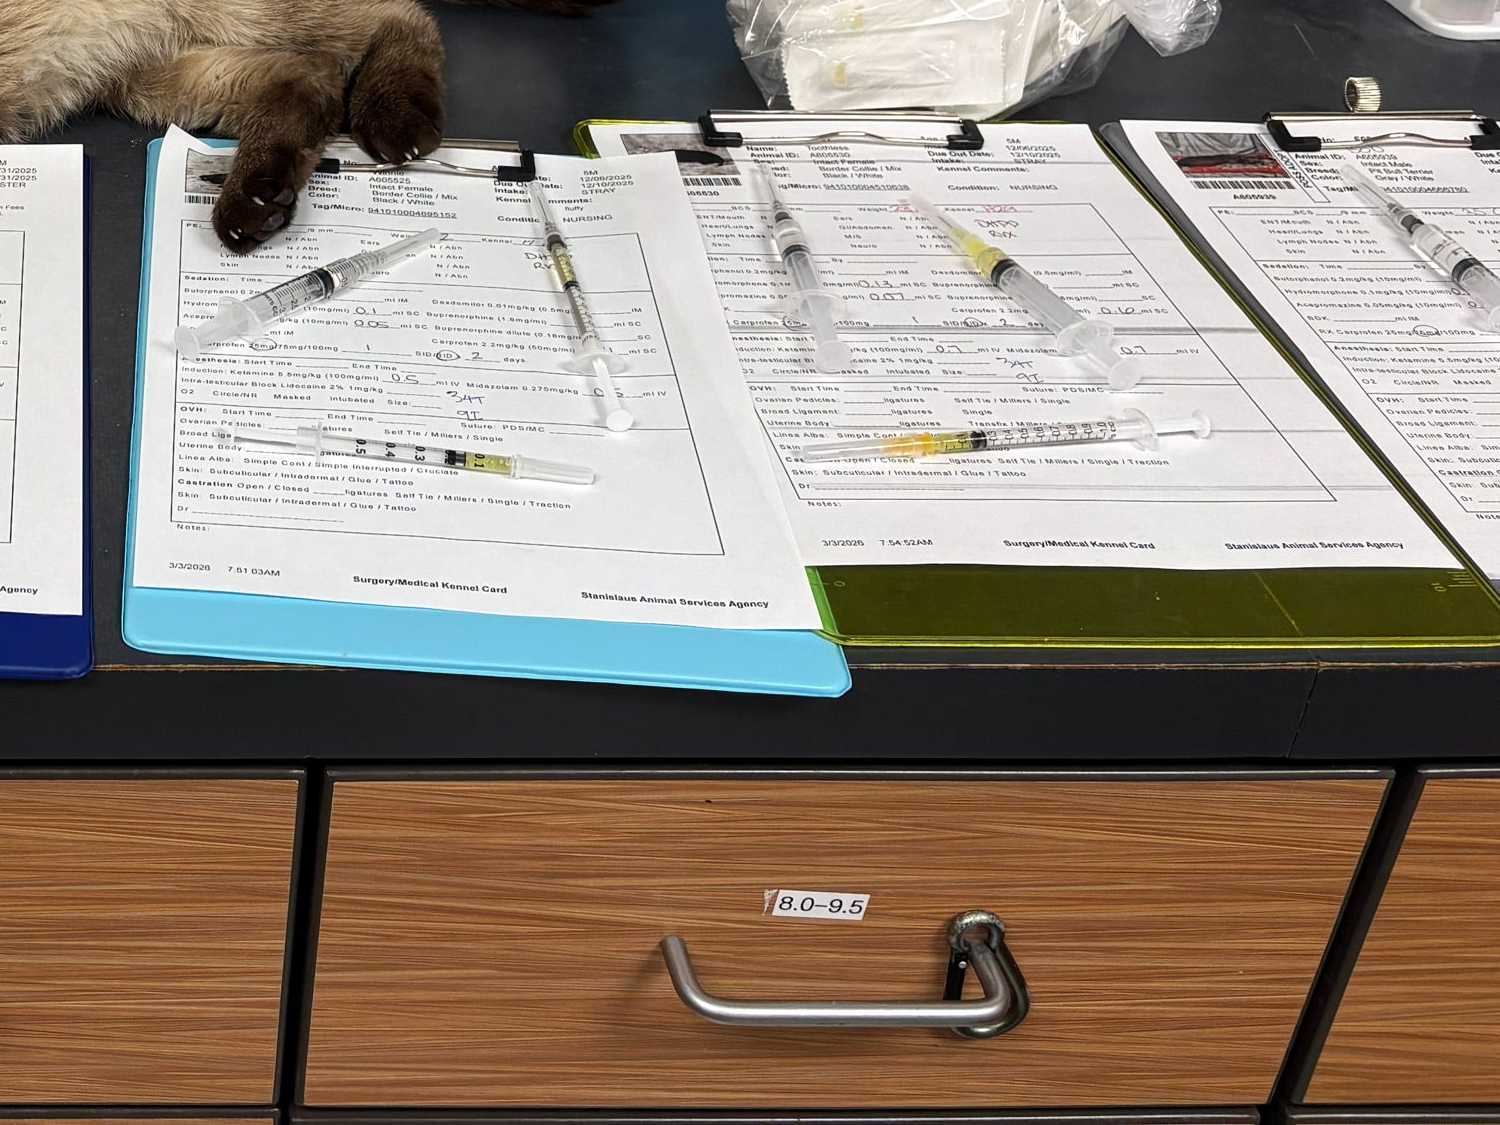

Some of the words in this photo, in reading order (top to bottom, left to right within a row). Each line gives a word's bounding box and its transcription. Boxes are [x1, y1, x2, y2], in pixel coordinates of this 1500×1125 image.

[311, 203, 364, 212] Tag/Micro:
[356, 438, 367, 455] 0.5
[384, 442, 396, 458] 0.4
[414, 445, 426, 462] 0.3
[474, 453, 485, 468] 0.1
[1004, 540, 1089, 548] Surgery/Medical
[169, 563, 210, 571] 3/3/2026
[0, 586, 38, 595] Agency
[354, 576, 438, 587] Surgery/Medical
[442, 582, 478, 591] Kennel
[581, 592, 637, 601] Stanislaus
[640, 596, 676, 604] Animal
[680, 599, 726, 607] Services
[779, 896, 864, 914] 8.0-9.5
